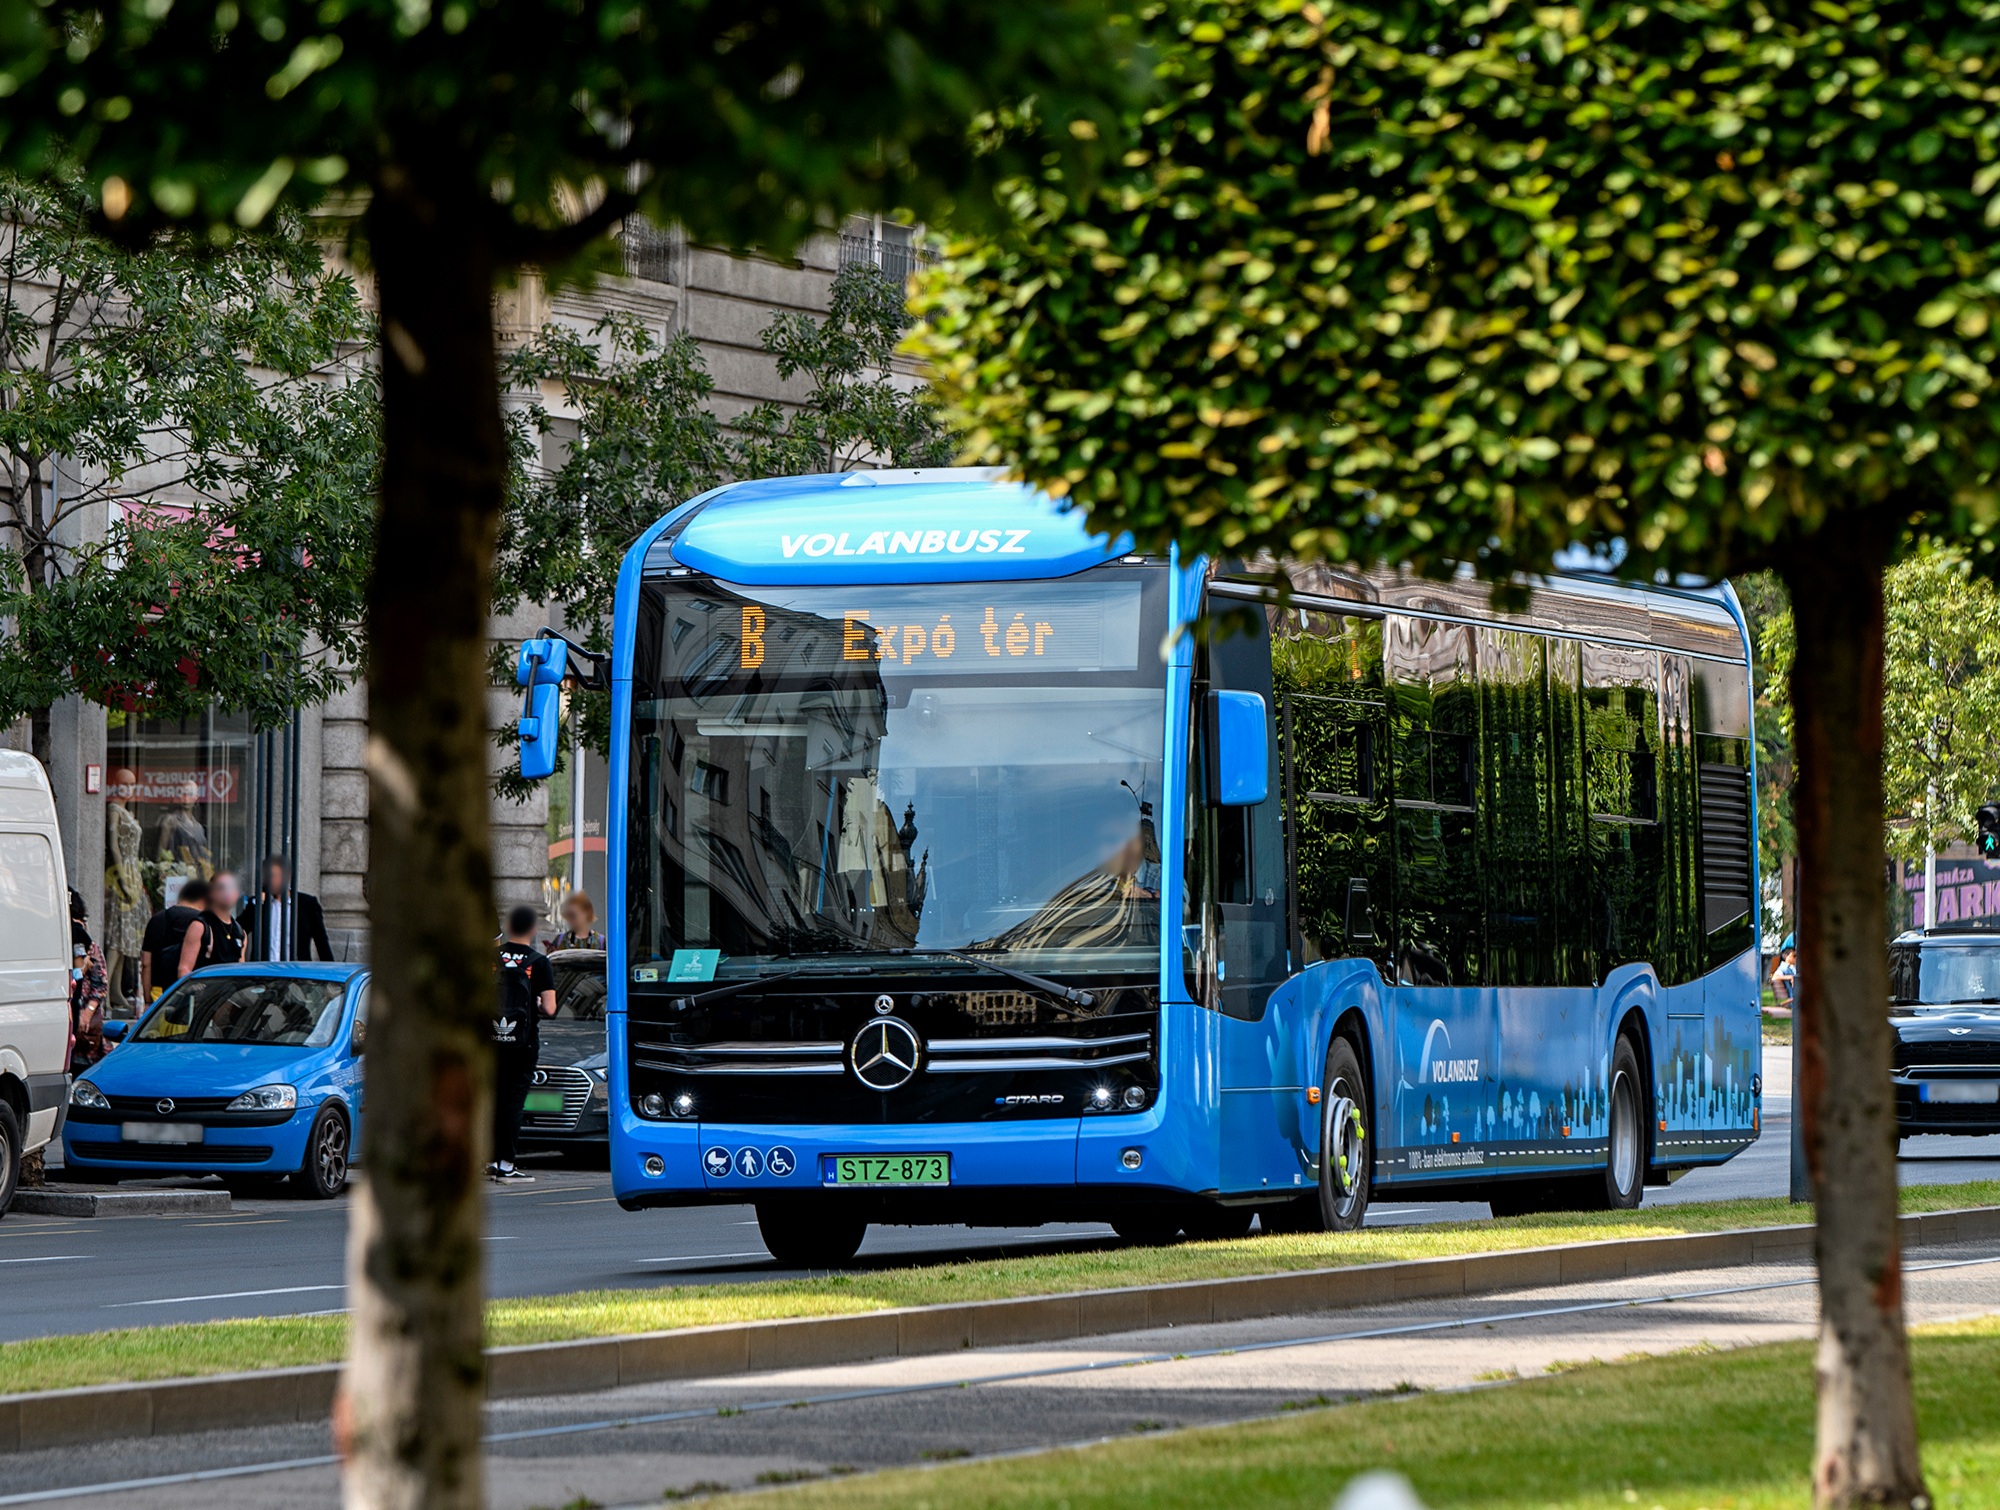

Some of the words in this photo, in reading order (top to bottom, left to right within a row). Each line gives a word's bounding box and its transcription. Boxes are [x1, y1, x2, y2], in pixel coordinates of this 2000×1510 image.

[781, 529, 1032, 558] VOLÁNBUSZ
[741, 606, 766, 668] B
[843, 610, 955, 665] Expó
[980, 607, 1054, 656] tér
[1904, 867, 1975, 891] VÁSHÁZA
[491, 1034, 517, 1042] adidas
[842, 1159, 942, 1181] STZ-873
